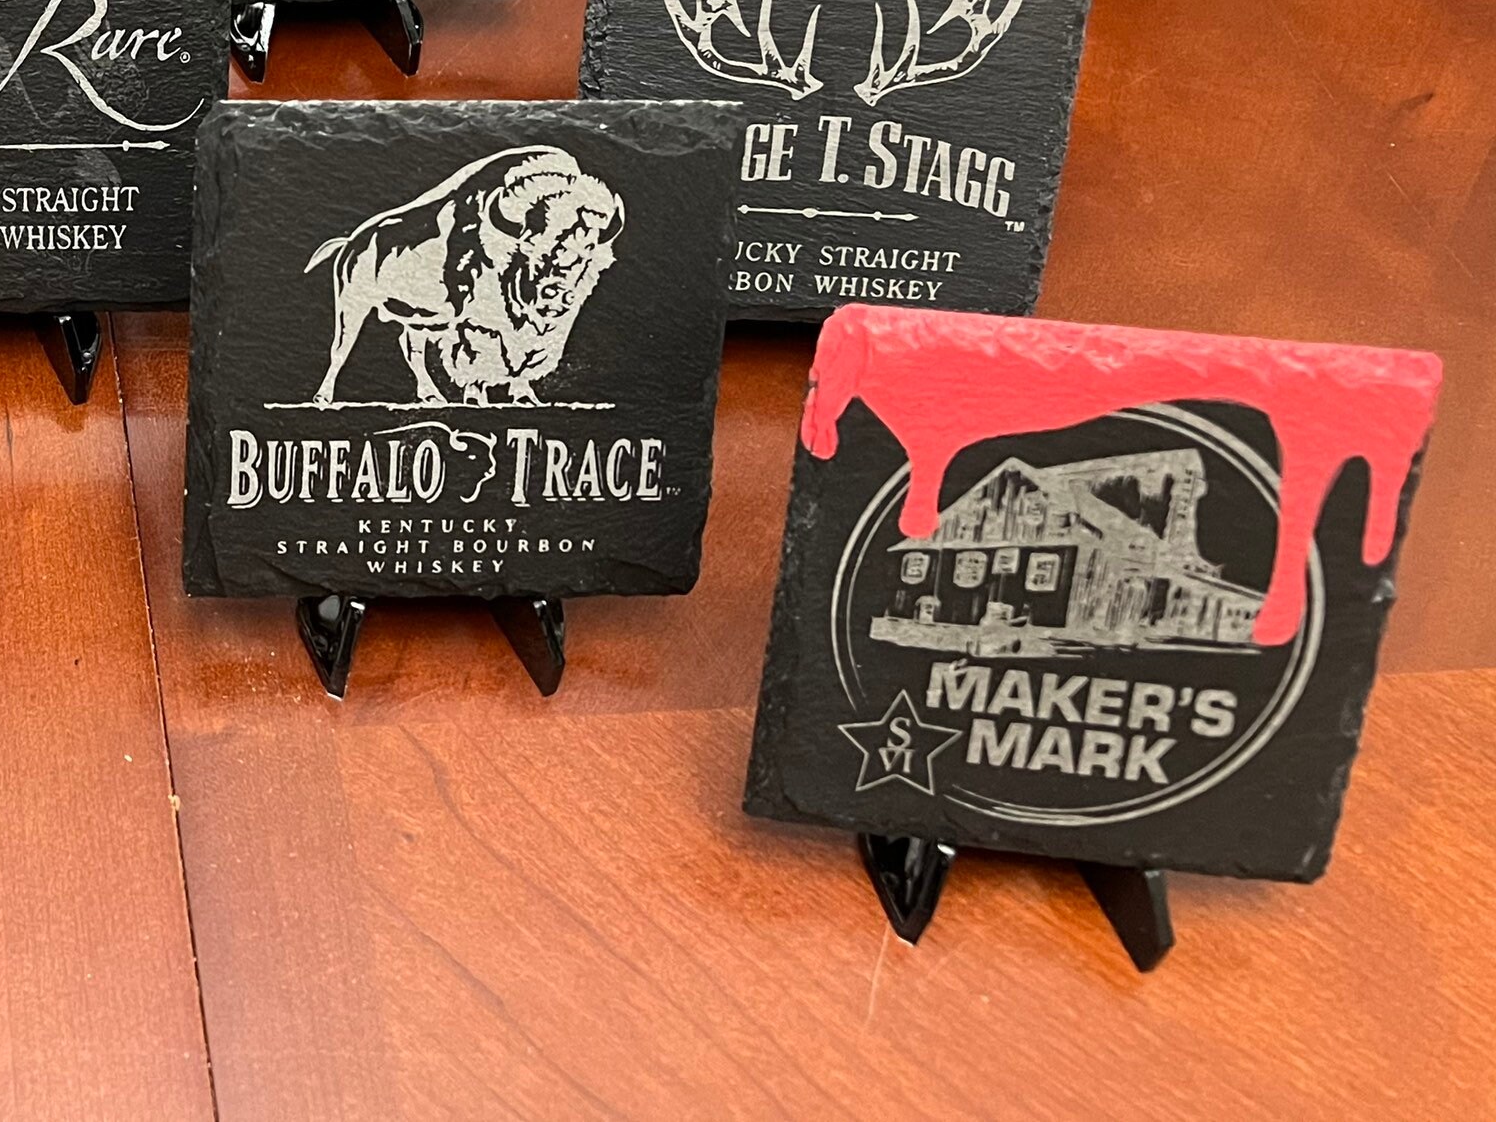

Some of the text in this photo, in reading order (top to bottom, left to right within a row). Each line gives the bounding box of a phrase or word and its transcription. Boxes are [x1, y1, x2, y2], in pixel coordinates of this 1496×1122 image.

[818, 115, 852, 184] T.
[863, 120, 1016, 218] STAGG
[1, 186, 140, 214] STRAIGHT
[2, 224, 127, 251] WHISKEY
[818, 245, 962, 273] STRAIGHT
[815, 274, 944, 302] WHISKEY
[226, 427, 666, 509] BUFFALO TRACE
[359, 518, 520, 535] KENTUCKY
[277, 538, 596, 555] STRAIGHT BOURBON
[366, 559, 505, 575] WHISKEY
[926, 659, 1238, 738] MAKER'S
[965, 718, 1177, 785] MARK
